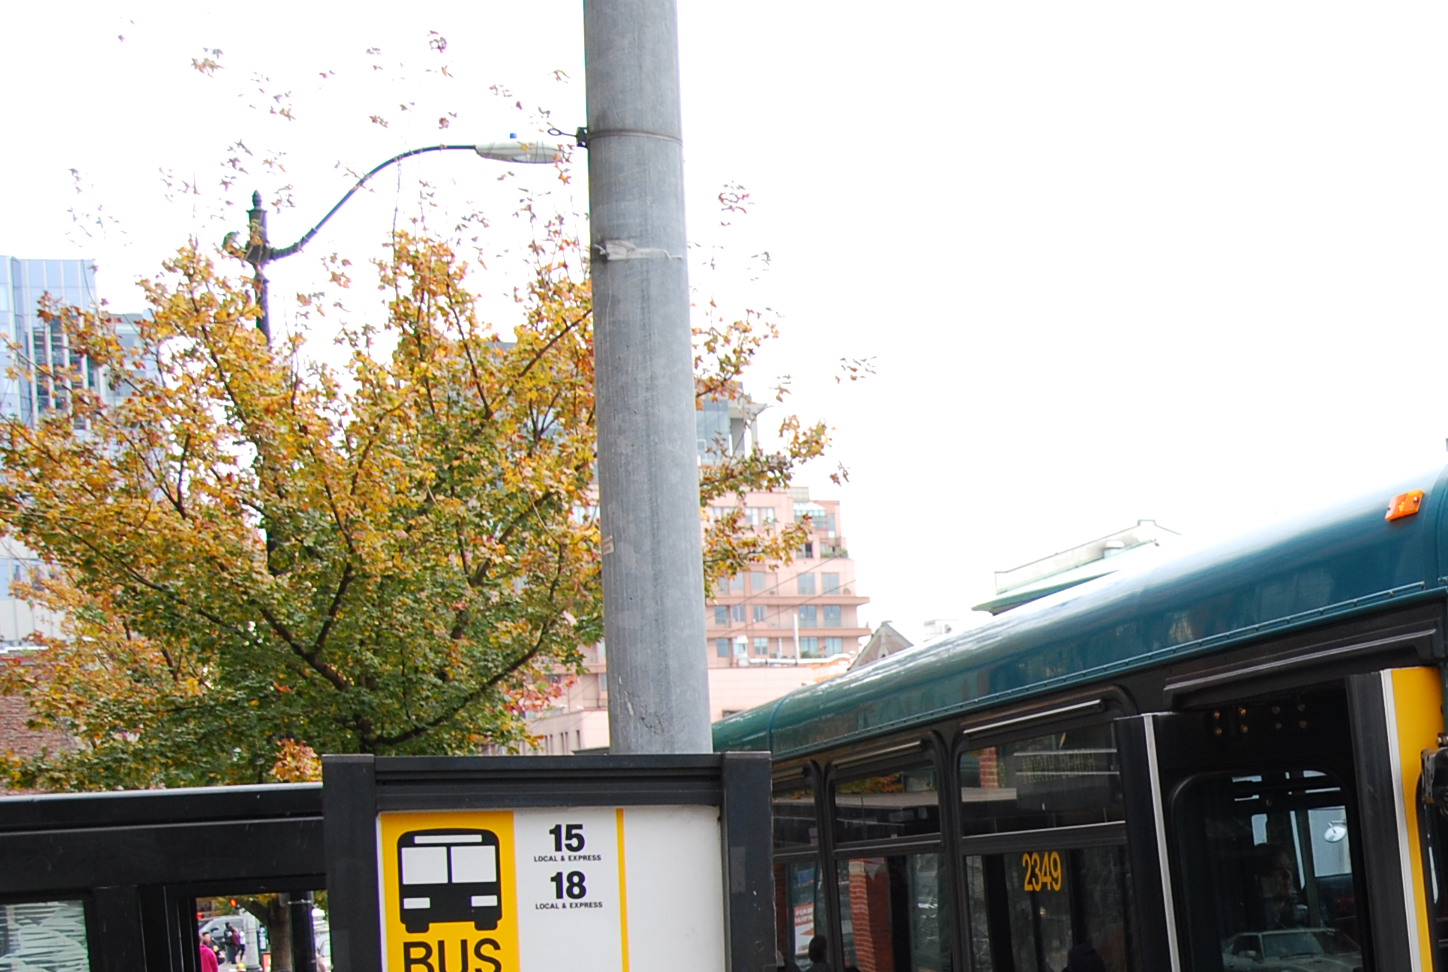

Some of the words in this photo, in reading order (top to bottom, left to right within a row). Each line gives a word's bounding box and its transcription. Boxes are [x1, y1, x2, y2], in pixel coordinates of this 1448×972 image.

[549, 824, 585, 852] 15
[550, 871, 587, 899] 18
[1022, 851, 1062, 891] 2349
